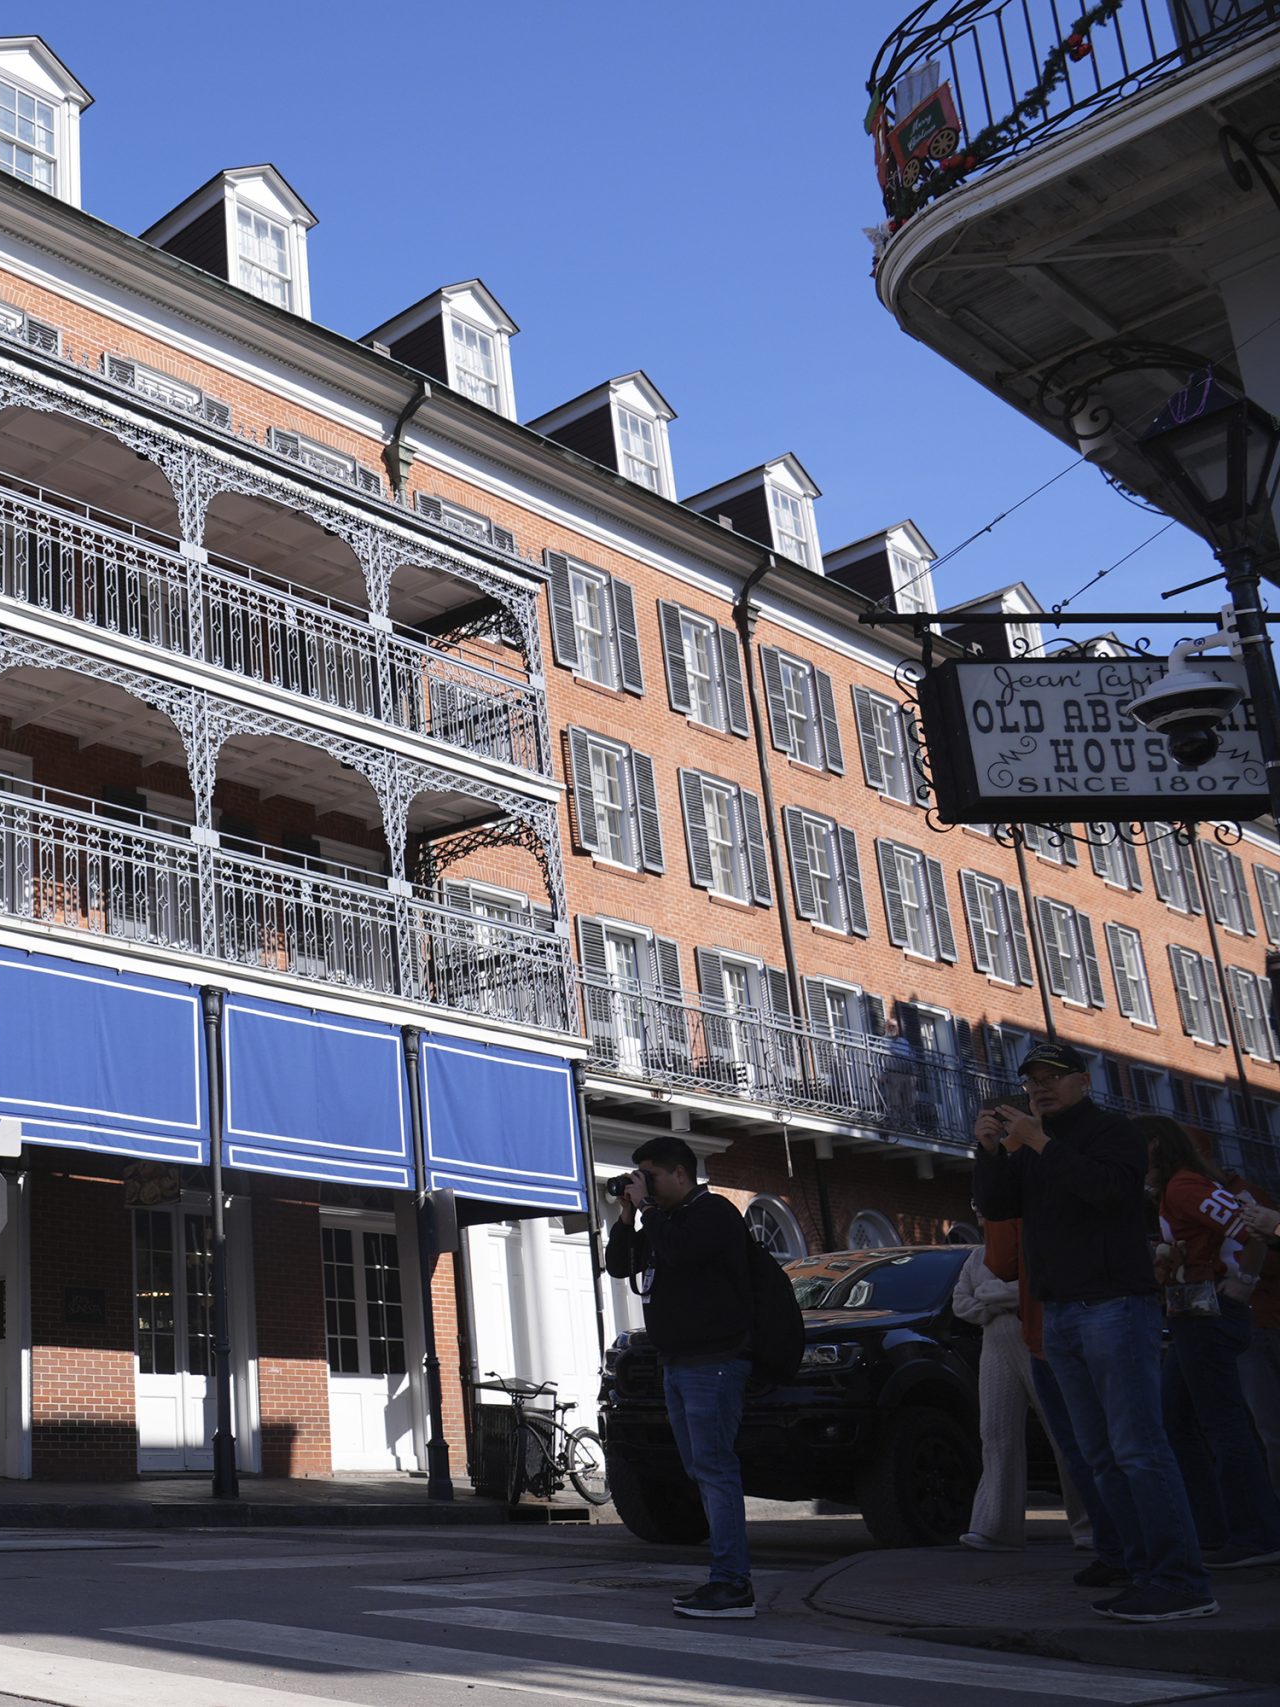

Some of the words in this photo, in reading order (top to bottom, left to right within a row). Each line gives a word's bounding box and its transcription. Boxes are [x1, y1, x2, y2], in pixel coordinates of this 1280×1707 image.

[972, 699, 1045, 734] OLD
[1050, 738, 1198, 773] HOUS
[1018, 776, 1130, 793] SINCE
[1155, 776, 1241, 792] 1807
[1199, 1188, 1240, 1226] 20
